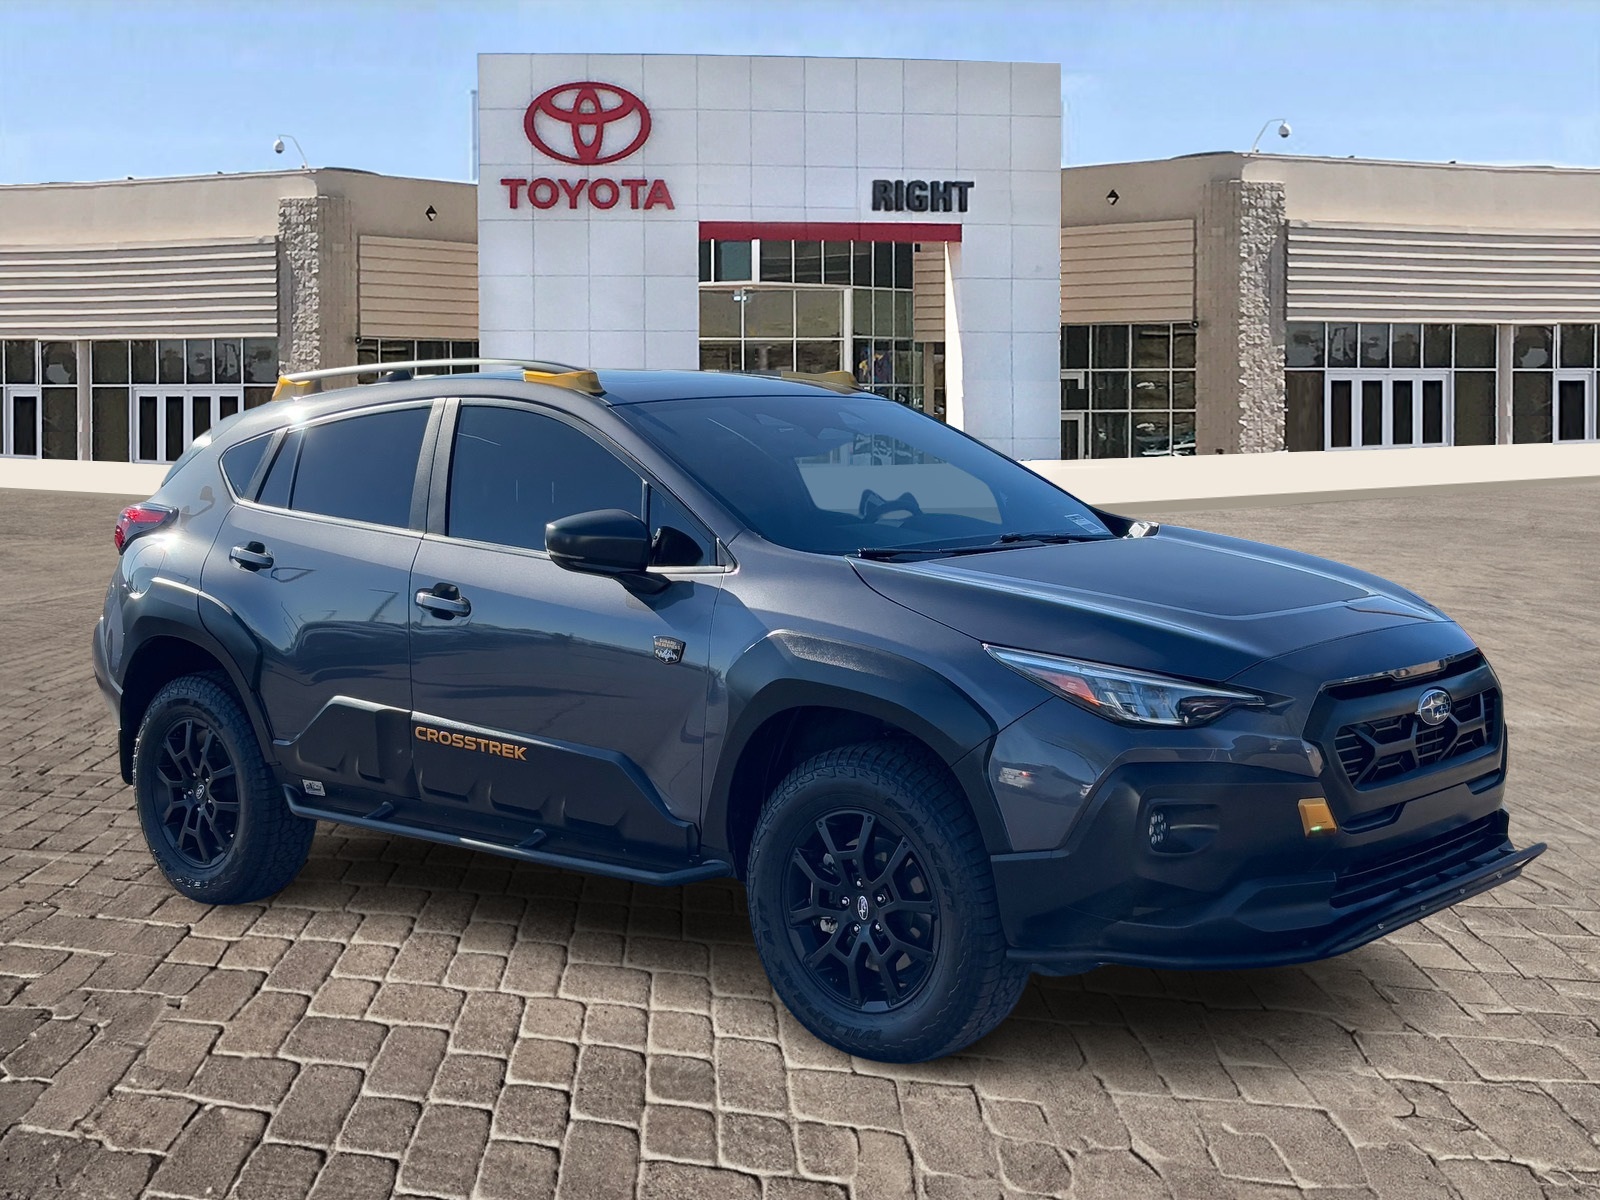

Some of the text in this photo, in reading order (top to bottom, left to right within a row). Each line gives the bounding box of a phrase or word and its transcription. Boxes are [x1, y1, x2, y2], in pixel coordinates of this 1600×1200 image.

[500, 178, 675, 210] TOYOTA
[872, 179, 975, 212] RIGHT
[414, 726, 528, 761] CROSSTREK
